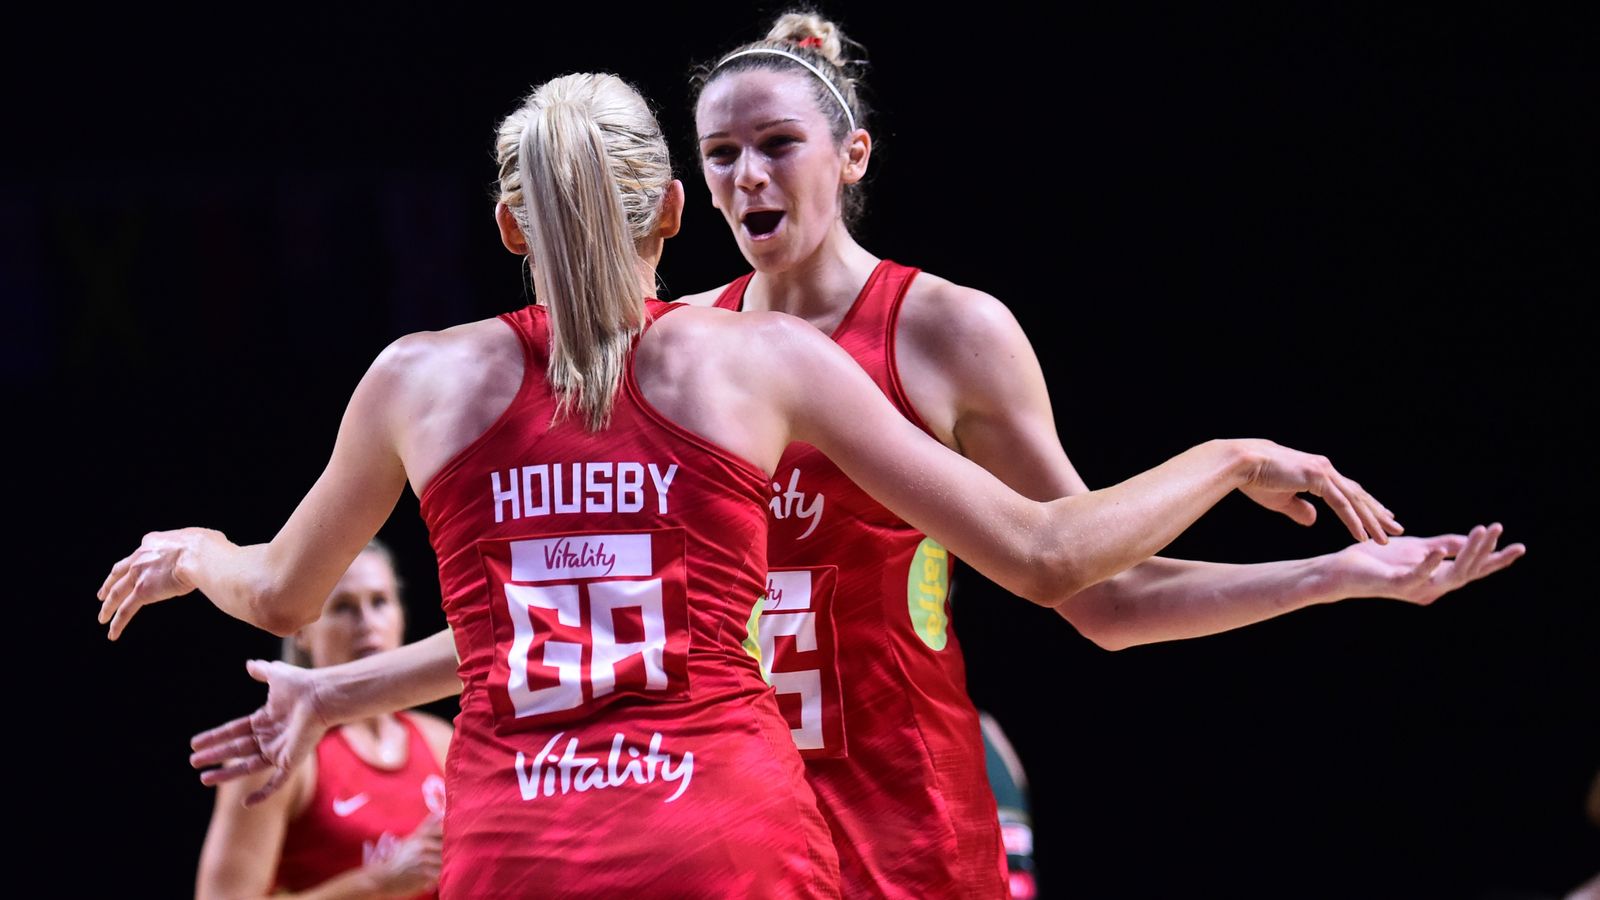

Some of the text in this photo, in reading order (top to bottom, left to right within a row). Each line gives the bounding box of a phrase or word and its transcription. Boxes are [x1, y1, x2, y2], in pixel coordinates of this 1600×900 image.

[490, 461, 678, 524] HOUSBY
[544, 537, 616, 576] Vitality
[503, 577, 669, 719] GA
[756, 612, 825, 750] S
[514, 731, 694, 803] Vitality
